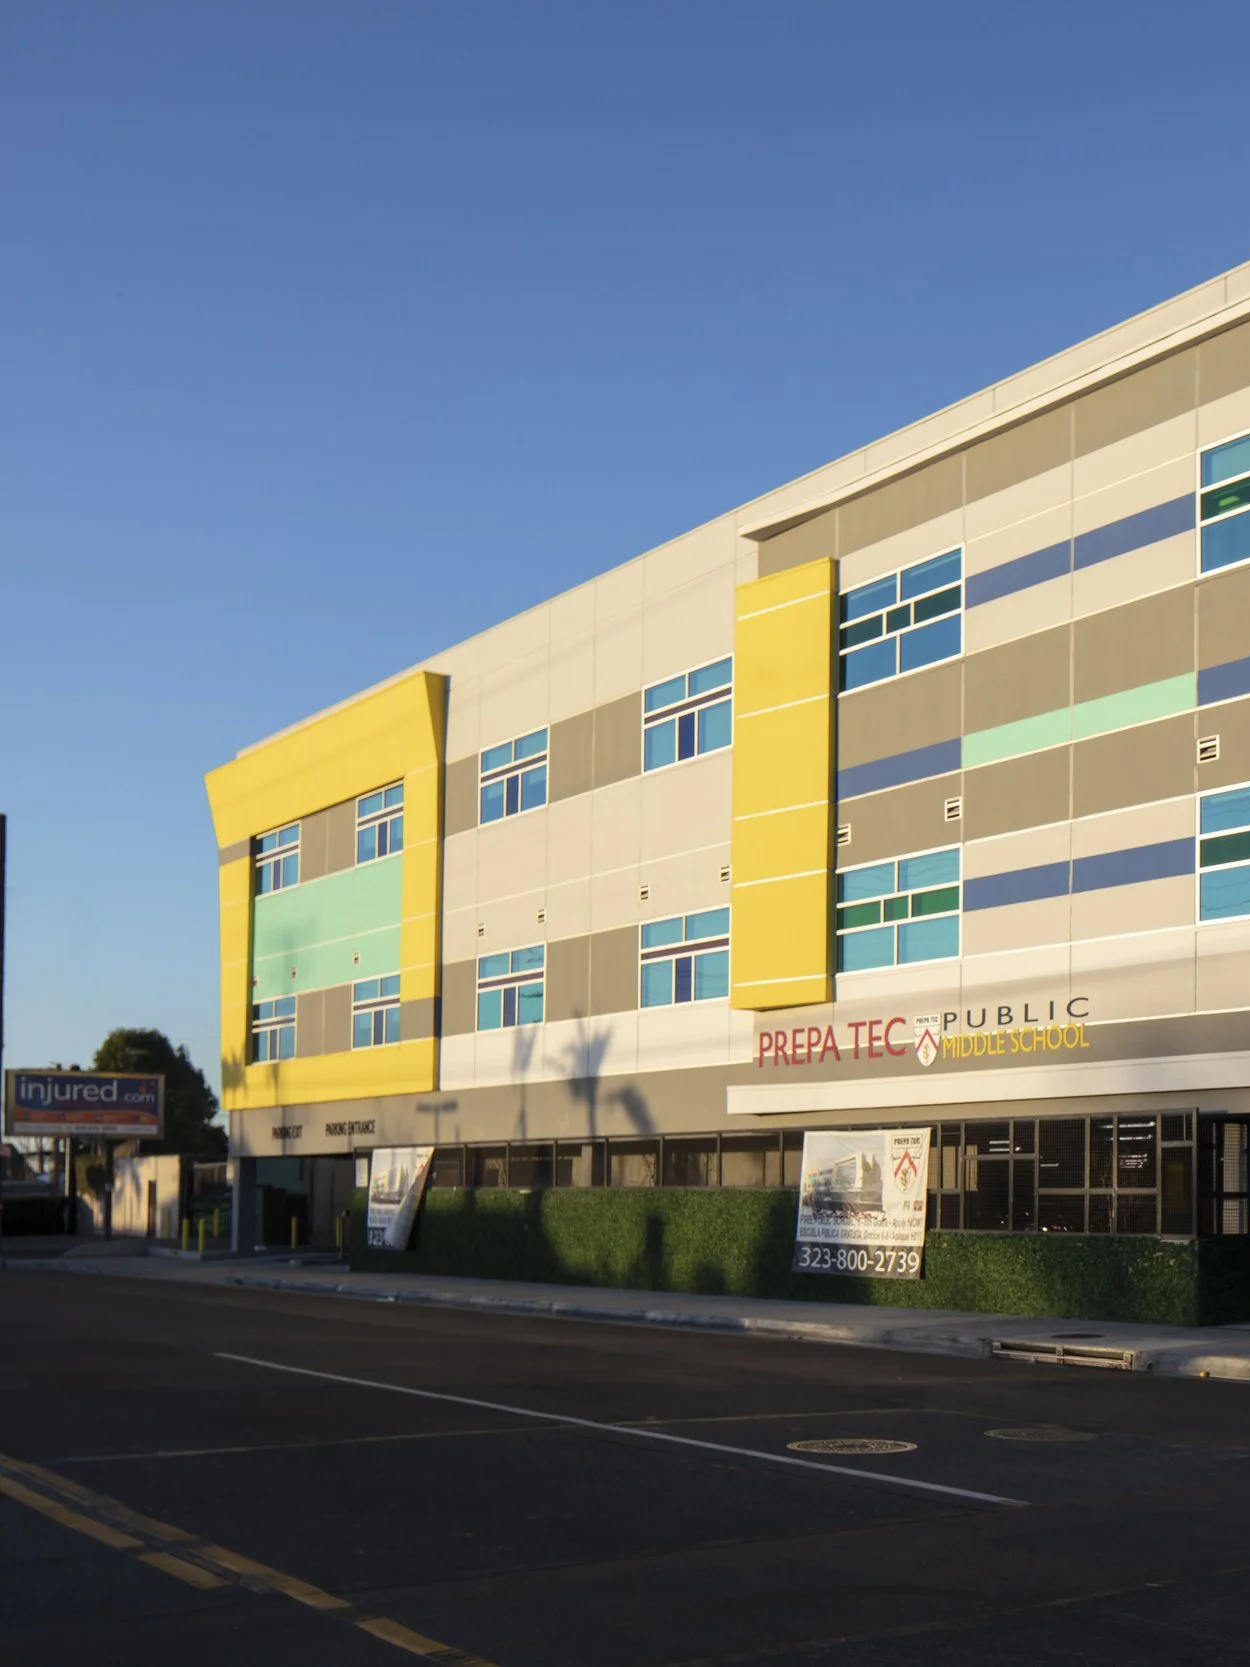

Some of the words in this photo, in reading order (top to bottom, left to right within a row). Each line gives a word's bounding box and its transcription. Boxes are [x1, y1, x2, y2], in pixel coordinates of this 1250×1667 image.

[943, 997, 1090, 1031] PUBLIC
[759, 1024, 841, 1068] PREPA
[847, 1016, 908, 1060] TEC
[942, 1029, 1006, 1059] MIDDLE
[1010, 1023, 1090, 1052] SCHOOL
[325, 1121, 347, 1137] PARKING
[347, 1119, 376, 1136] ENTRANCE
[799, 1247, 920, 1273] 323-800-2739
